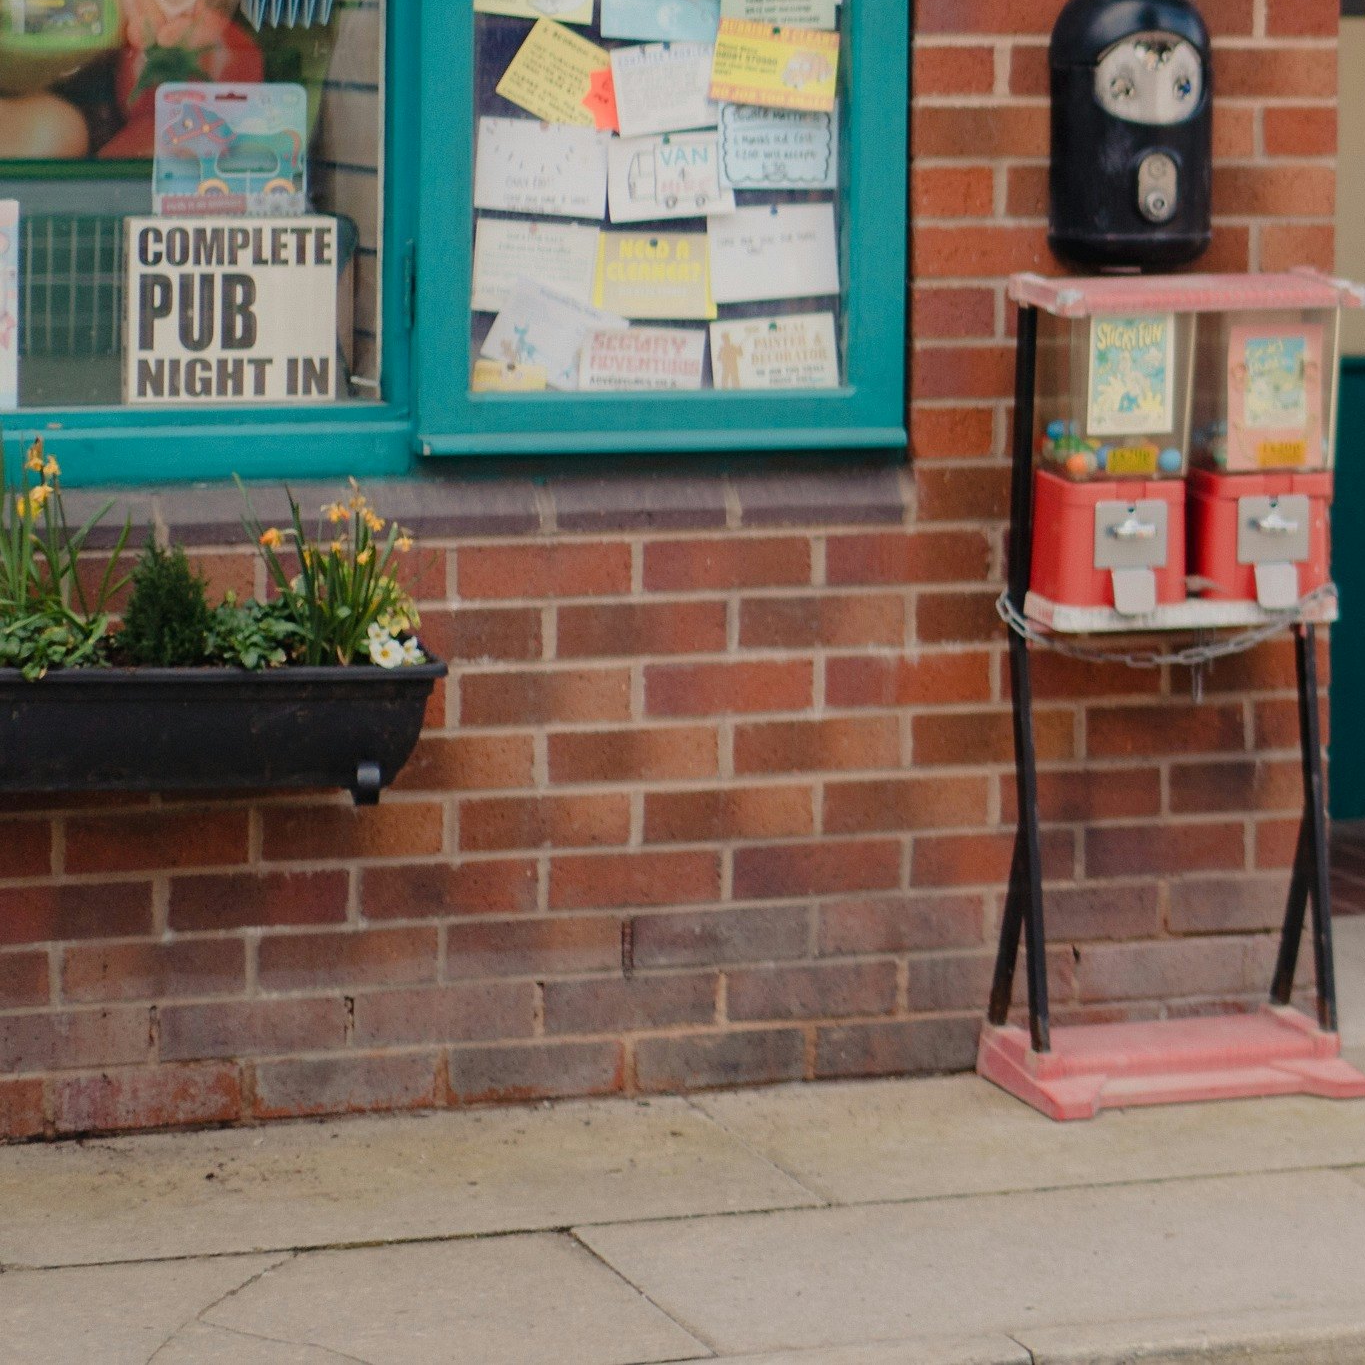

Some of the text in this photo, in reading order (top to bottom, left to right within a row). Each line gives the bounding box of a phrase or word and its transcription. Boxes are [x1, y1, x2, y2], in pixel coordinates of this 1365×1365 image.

[661, 147, 709, 166] VAN
[137, 226, 333, 267] COMPLETE
[137, 273, 258, 352] PUB
[137, 356, 330, 398] NIGHT IN
